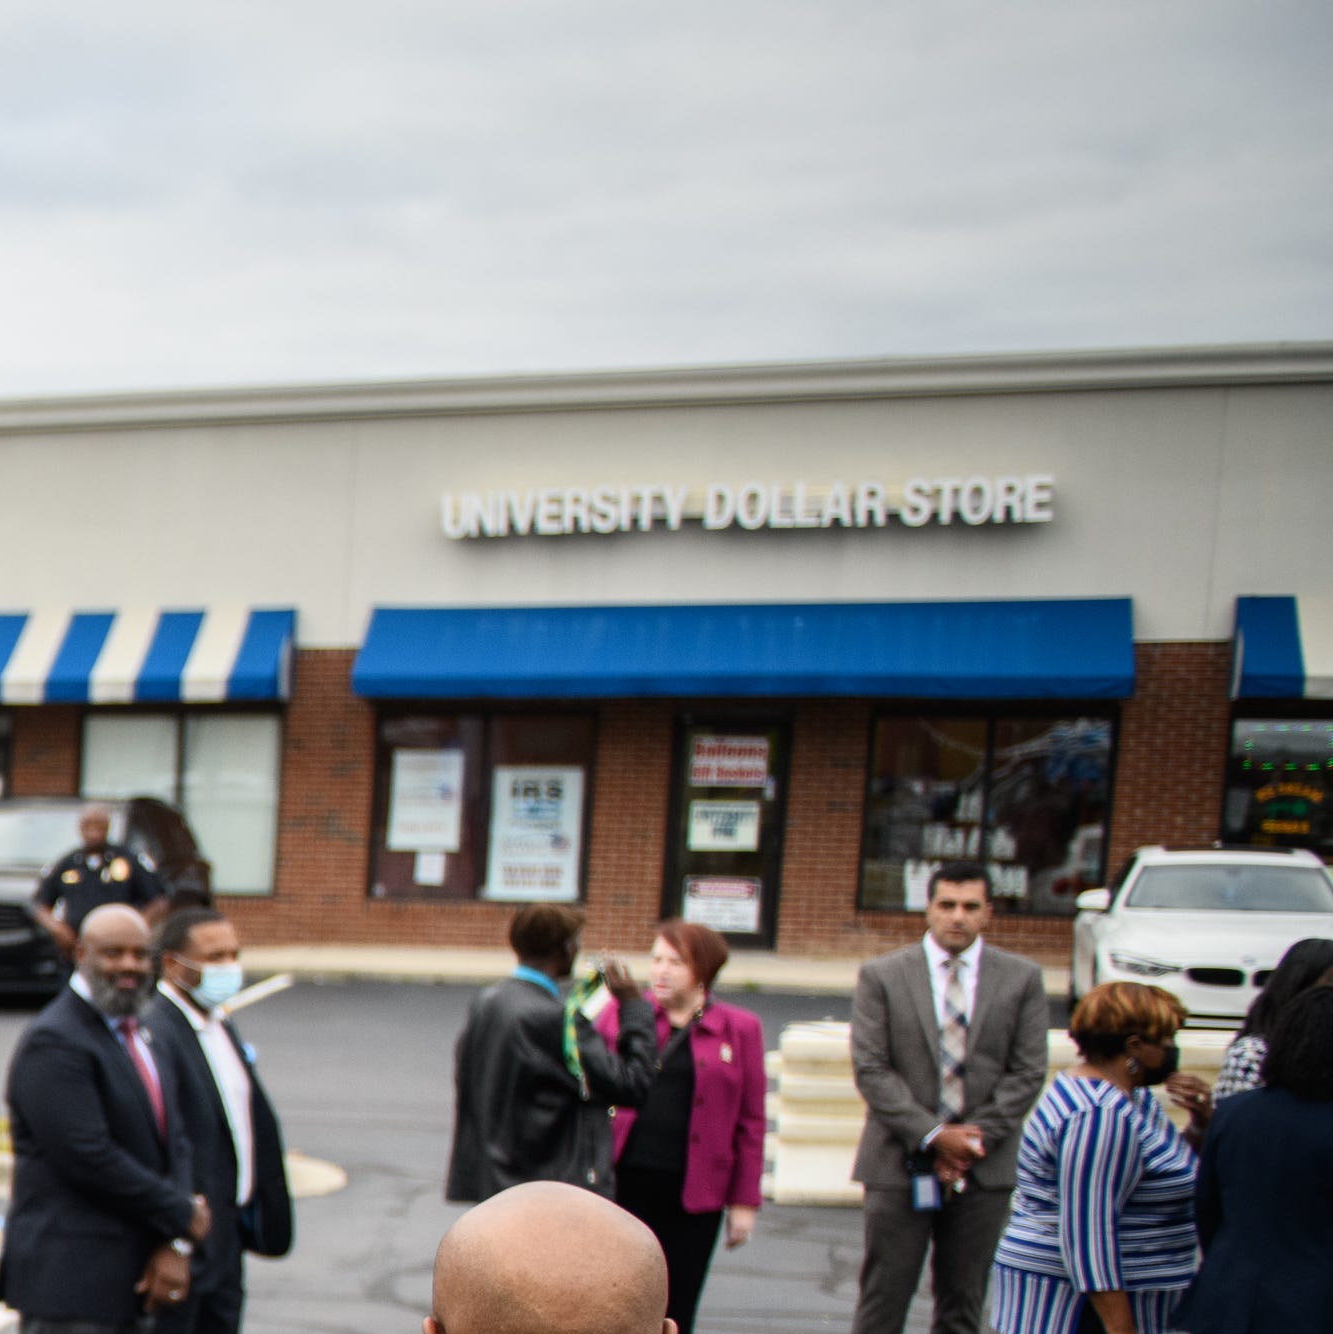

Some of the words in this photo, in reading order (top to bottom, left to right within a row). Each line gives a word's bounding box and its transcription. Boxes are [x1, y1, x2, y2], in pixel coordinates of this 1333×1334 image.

[442, 484, 688, 539] UNIVERSITY
[704, 481, 885, 530] DOLLAR
[900, 474, 1055, 527] STORE
